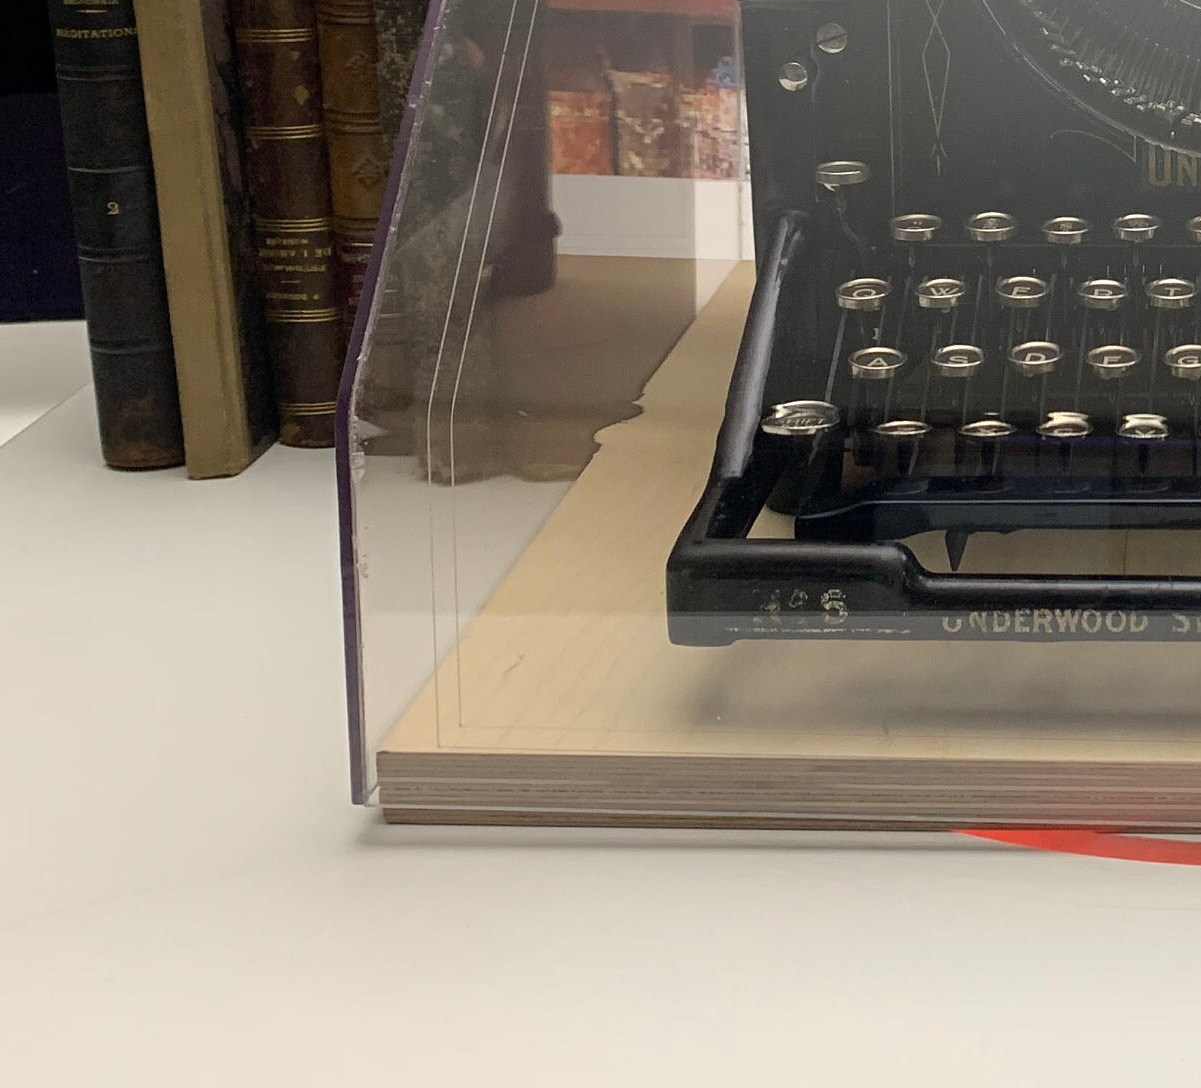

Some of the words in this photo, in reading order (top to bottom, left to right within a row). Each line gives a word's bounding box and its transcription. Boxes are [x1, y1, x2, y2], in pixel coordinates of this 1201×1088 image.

[56, 27, 137, 39] MEDITATION
[107, 202, 119, 215] 2
[942, 609, 1149, 633] UNDERWOOD
